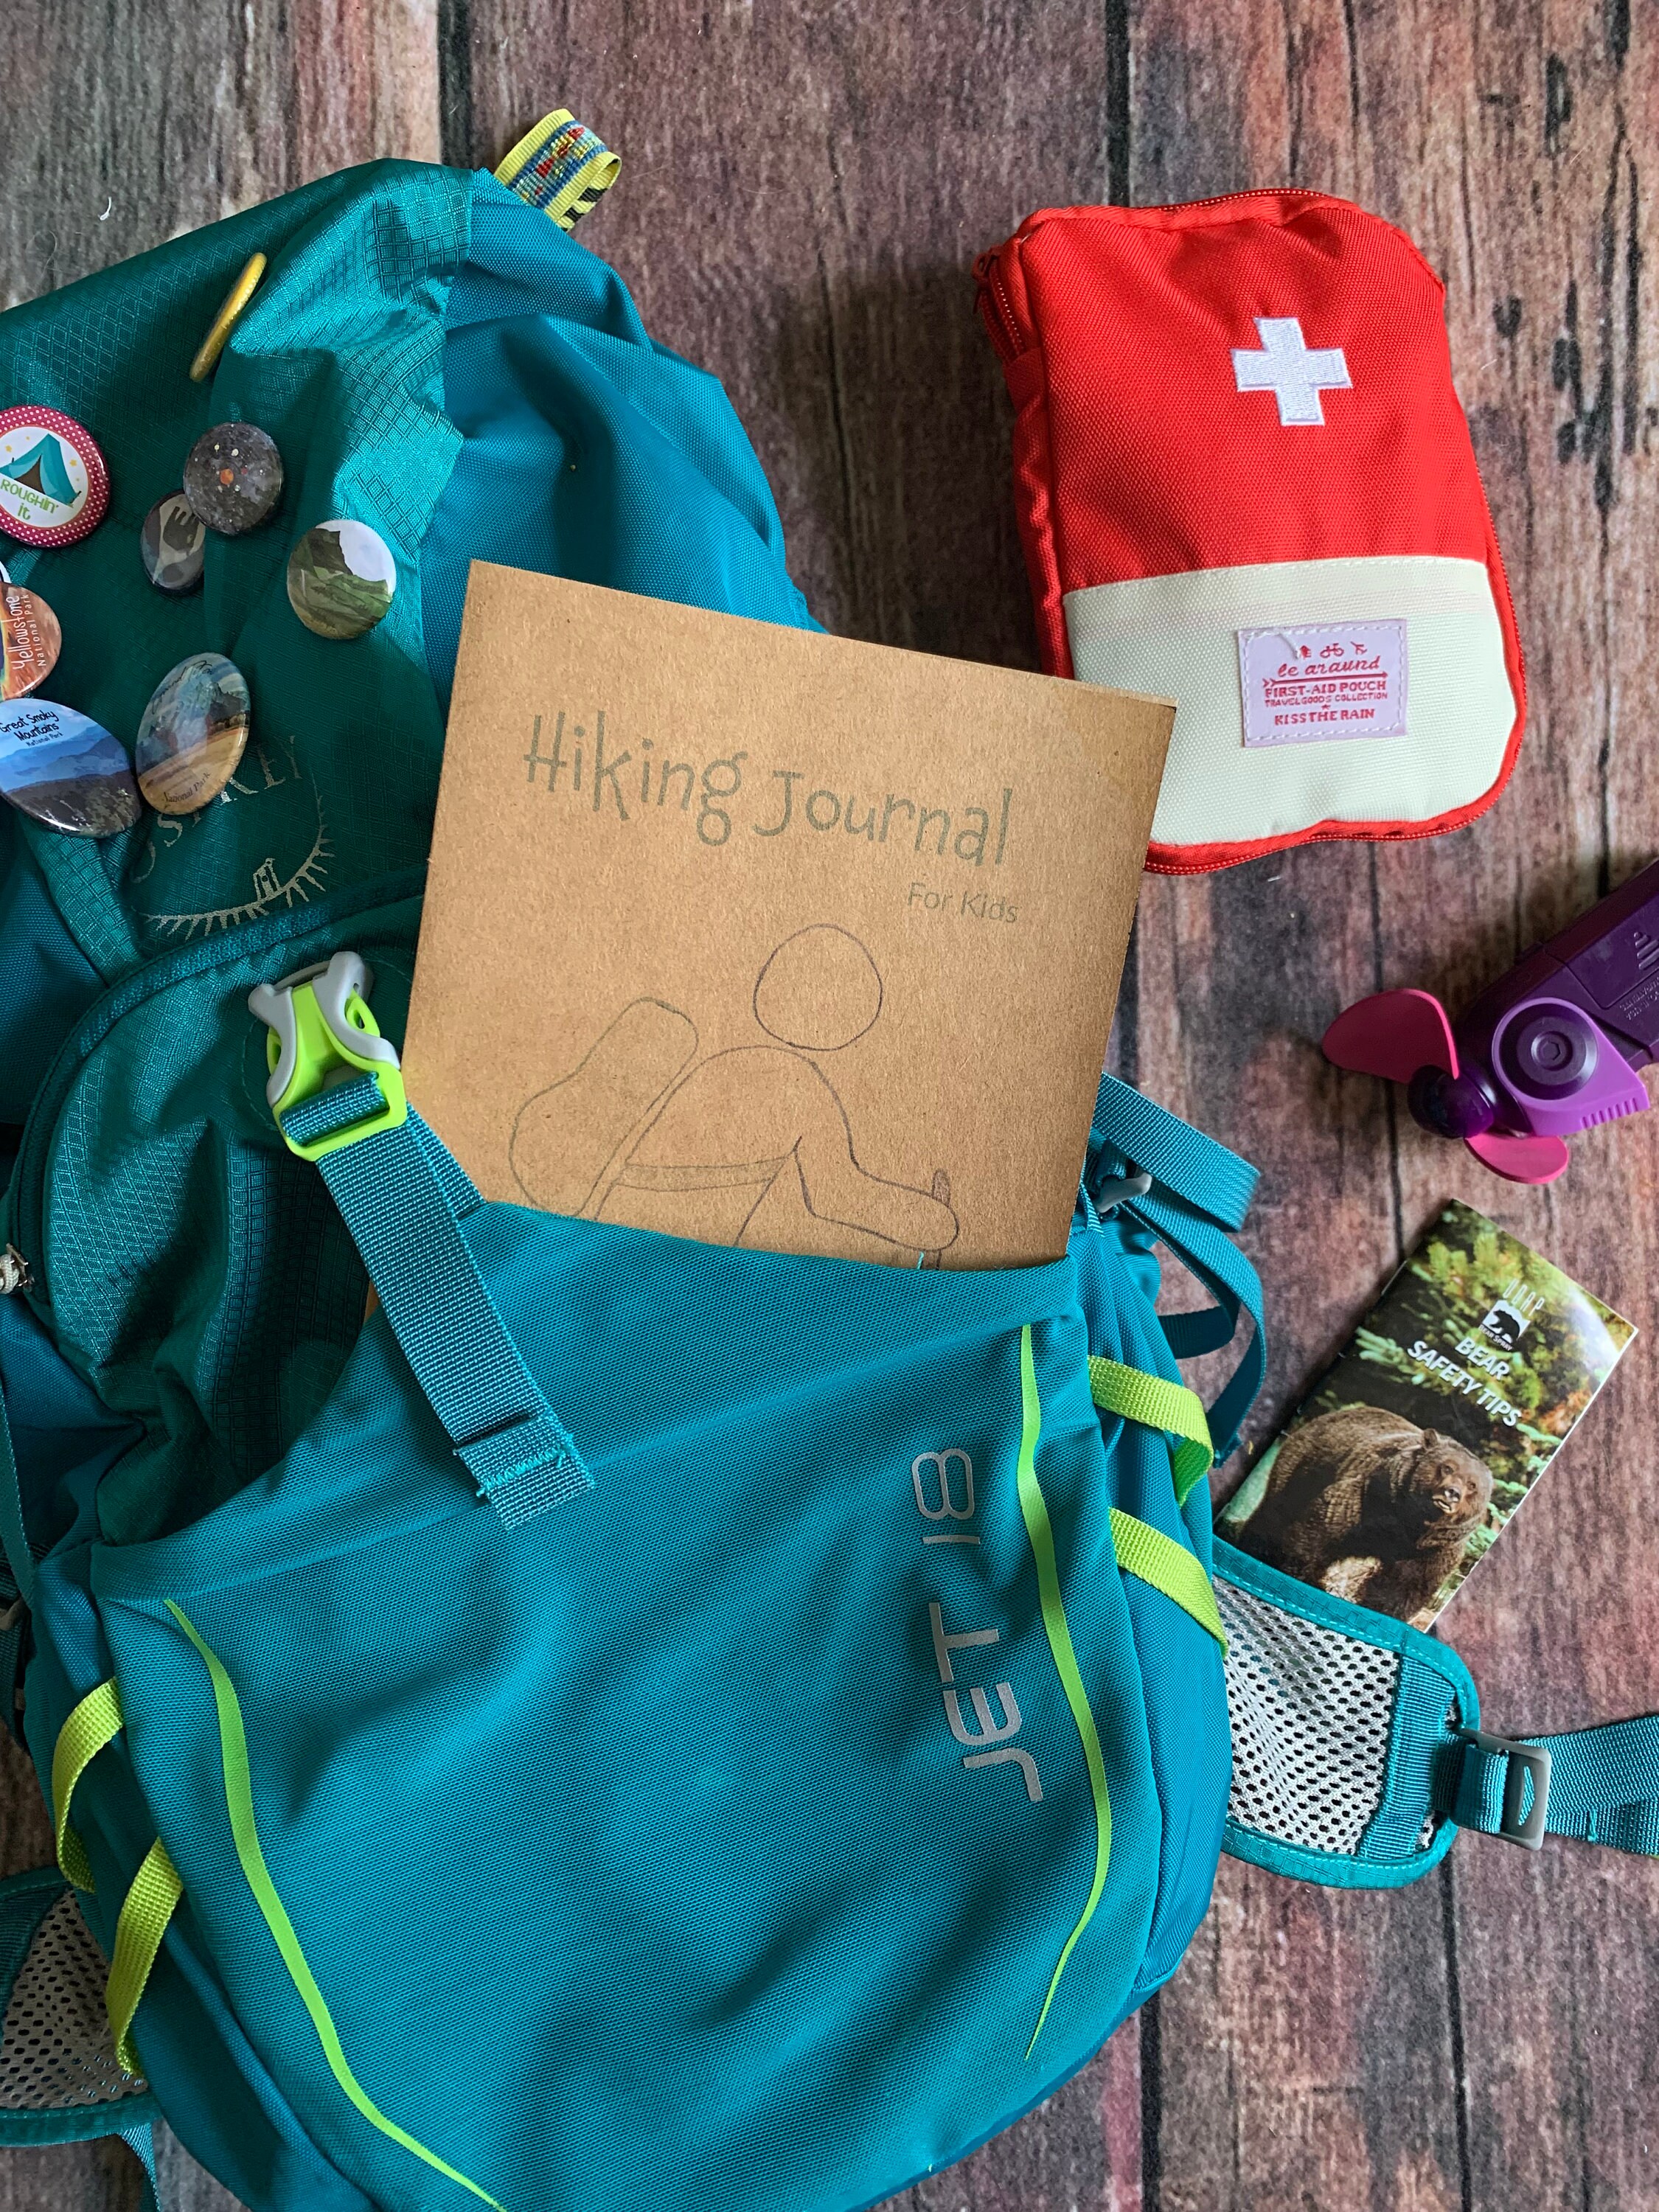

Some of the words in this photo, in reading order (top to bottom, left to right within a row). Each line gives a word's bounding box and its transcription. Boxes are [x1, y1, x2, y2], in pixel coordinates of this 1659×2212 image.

[20, 594, 34, 615] Park
[0, 595, 35, 669] Yellowstone
[27, 619, 46, 667] National
[1265, 683, 1337, 698] FIRST-AID
[1339, 681, 1386, 692] POUCH
[1335, 692, 1388, 703] COLLECTION
[0, 717, 29, 732] Great
[26, 709, 59, 723] Smoky
[13, 723, 59, 741] Mountains
[1340, 709, 1375, 720] RAIN
[26, 736, 50, 747] National
[523, 709, 748, 846] Hiking
[752, 770, 1013, 867] Journal
[908, 882, 953, 911] For
[960, 891, 1019, 925] Kids
[1478, 1324, 1495, 1340] BEAR
[1492, 1335, 1513, 1351] SPRAY
[1455, 1336, 1510, 1381] BEAR
[1407, 1340, 1483, 1396] SAFETY
[1476, 1388, 1523, 1427] TIPS
[911, 1447, 981, 1545] 18
[928, 1602, 1044, 1802] JET
